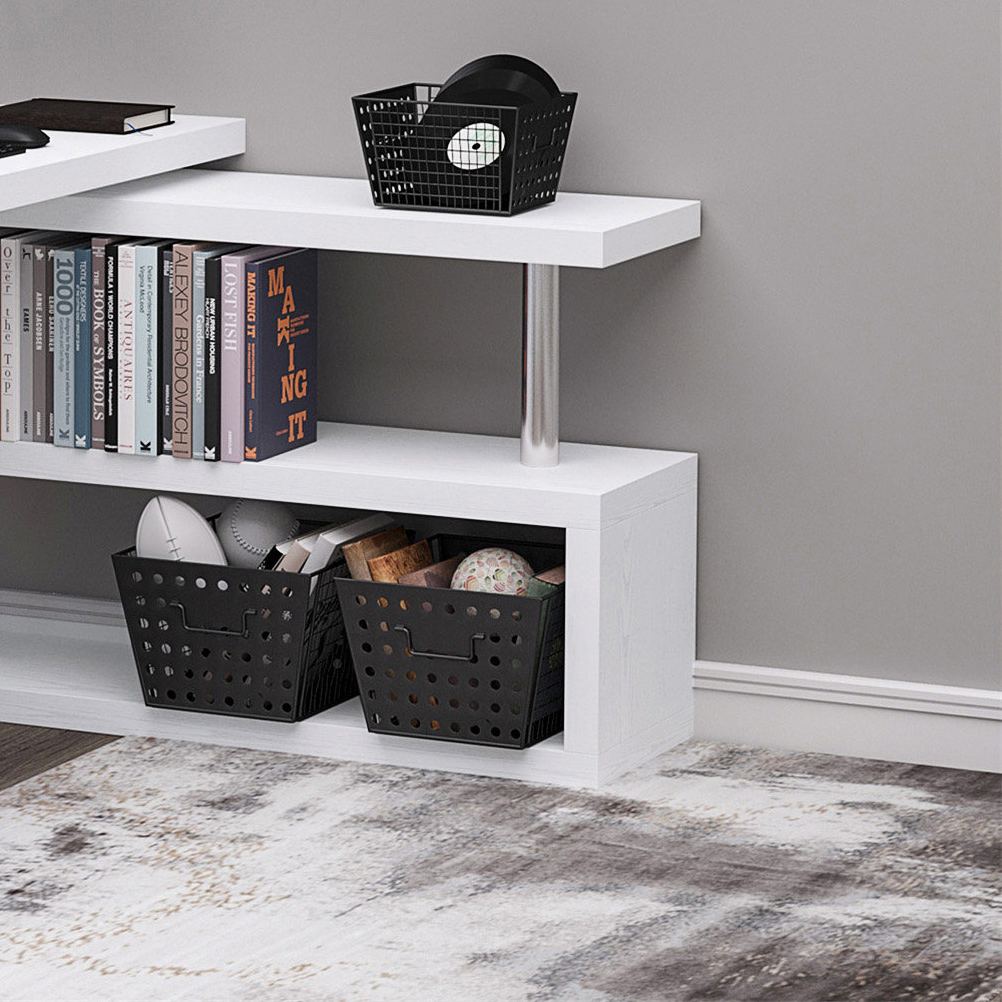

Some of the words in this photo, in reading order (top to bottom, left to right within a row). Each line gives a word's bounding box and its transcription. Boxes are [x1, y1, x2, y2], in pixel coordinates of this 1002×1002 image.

[56, 258, 74, 315] 1000
[175, 251, 188, 322] ALEXEY
[225, 263, 238, 308] LOST
[247, 272, 256, 322] MAKING
[93, 289, 104, 330] BOOK
[93, 334, 99, 345] OF
[122, 299, 133, 401] ANTIQUAIRES
[195, 314, 204, 356] Gardens
[225, 311, 237, 351] FISH
[247, 325, 256, 337] IT
[195, 357, 204, 367] in
[92, 347, 105, 421] SYMBOLS
[174, 327, 188, 444] BRODOVITCH
[195, 369, 204, 404] France
[288, 410, 307, 443] IT
